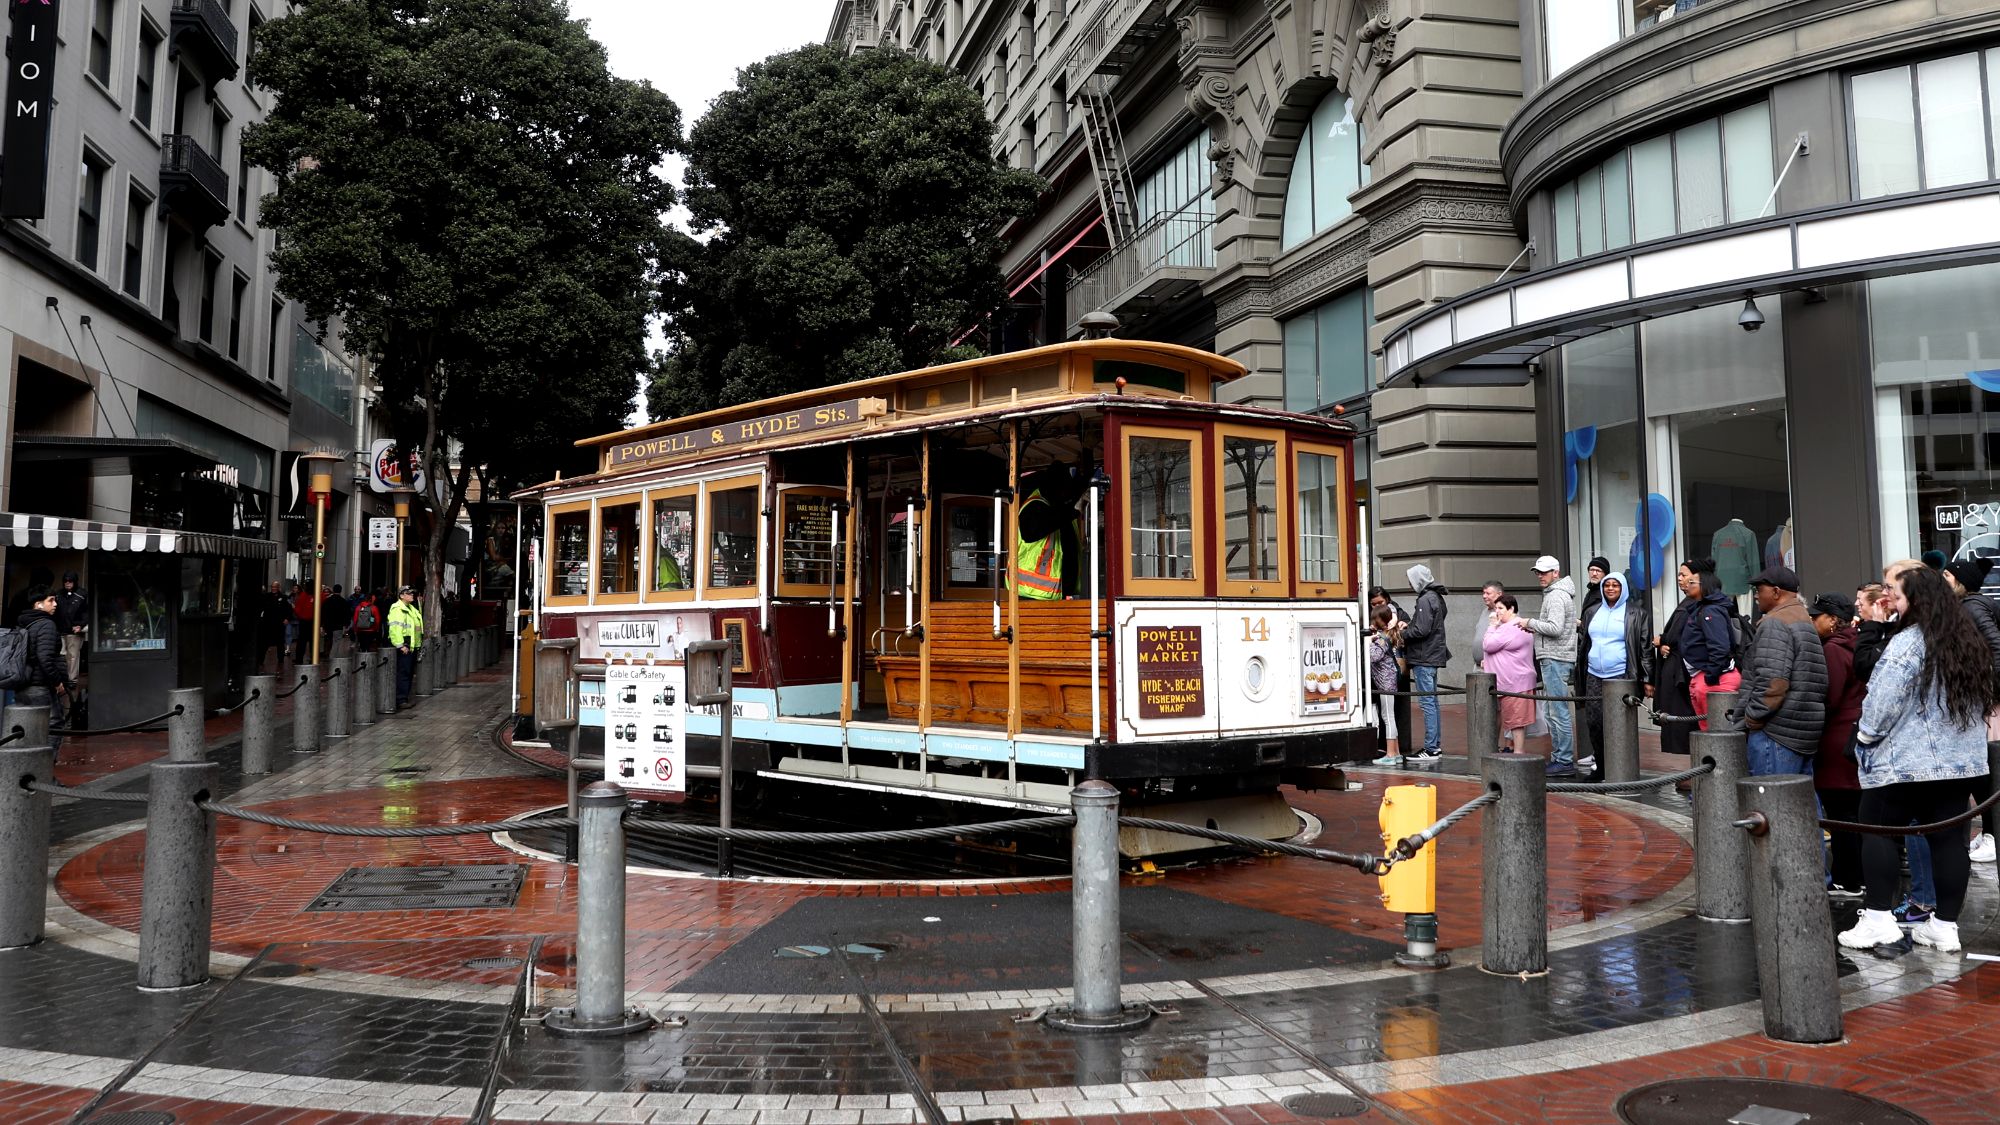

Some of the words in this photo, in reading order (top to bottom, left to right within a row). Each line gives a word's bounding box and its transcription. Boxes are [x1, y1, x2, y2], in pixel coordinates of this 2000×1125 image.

[16, 12, 42, 118] IOM
[620, 436, 697, 460] POWELL
[711, 429, 725, 443] &
[741, 414, 800, 438] HYDE
[814, 407, 850, 425] Sts.
[1939, 511, 1959, 524] GAP
[1964, 503, 1989, 526] &
[1241, 616, 1270, 641] 14
[1140, 631, 1197, 641] POWELL
[1156, 642, 1184, 651] AND
[1139, 651, 1199, 662] MARKET
[609, 670, 628, 678] Cable
[630, 671, 641, 679] Car
[643, 671, 666, 682] Safety
[1142, 679, 1162, 692] HYDE
[1175, 679, 1200, 691] BEACH
[1147, 694, 1196, 704] FISHERMANS
[1159, 704, 1185, 713] WHARF
